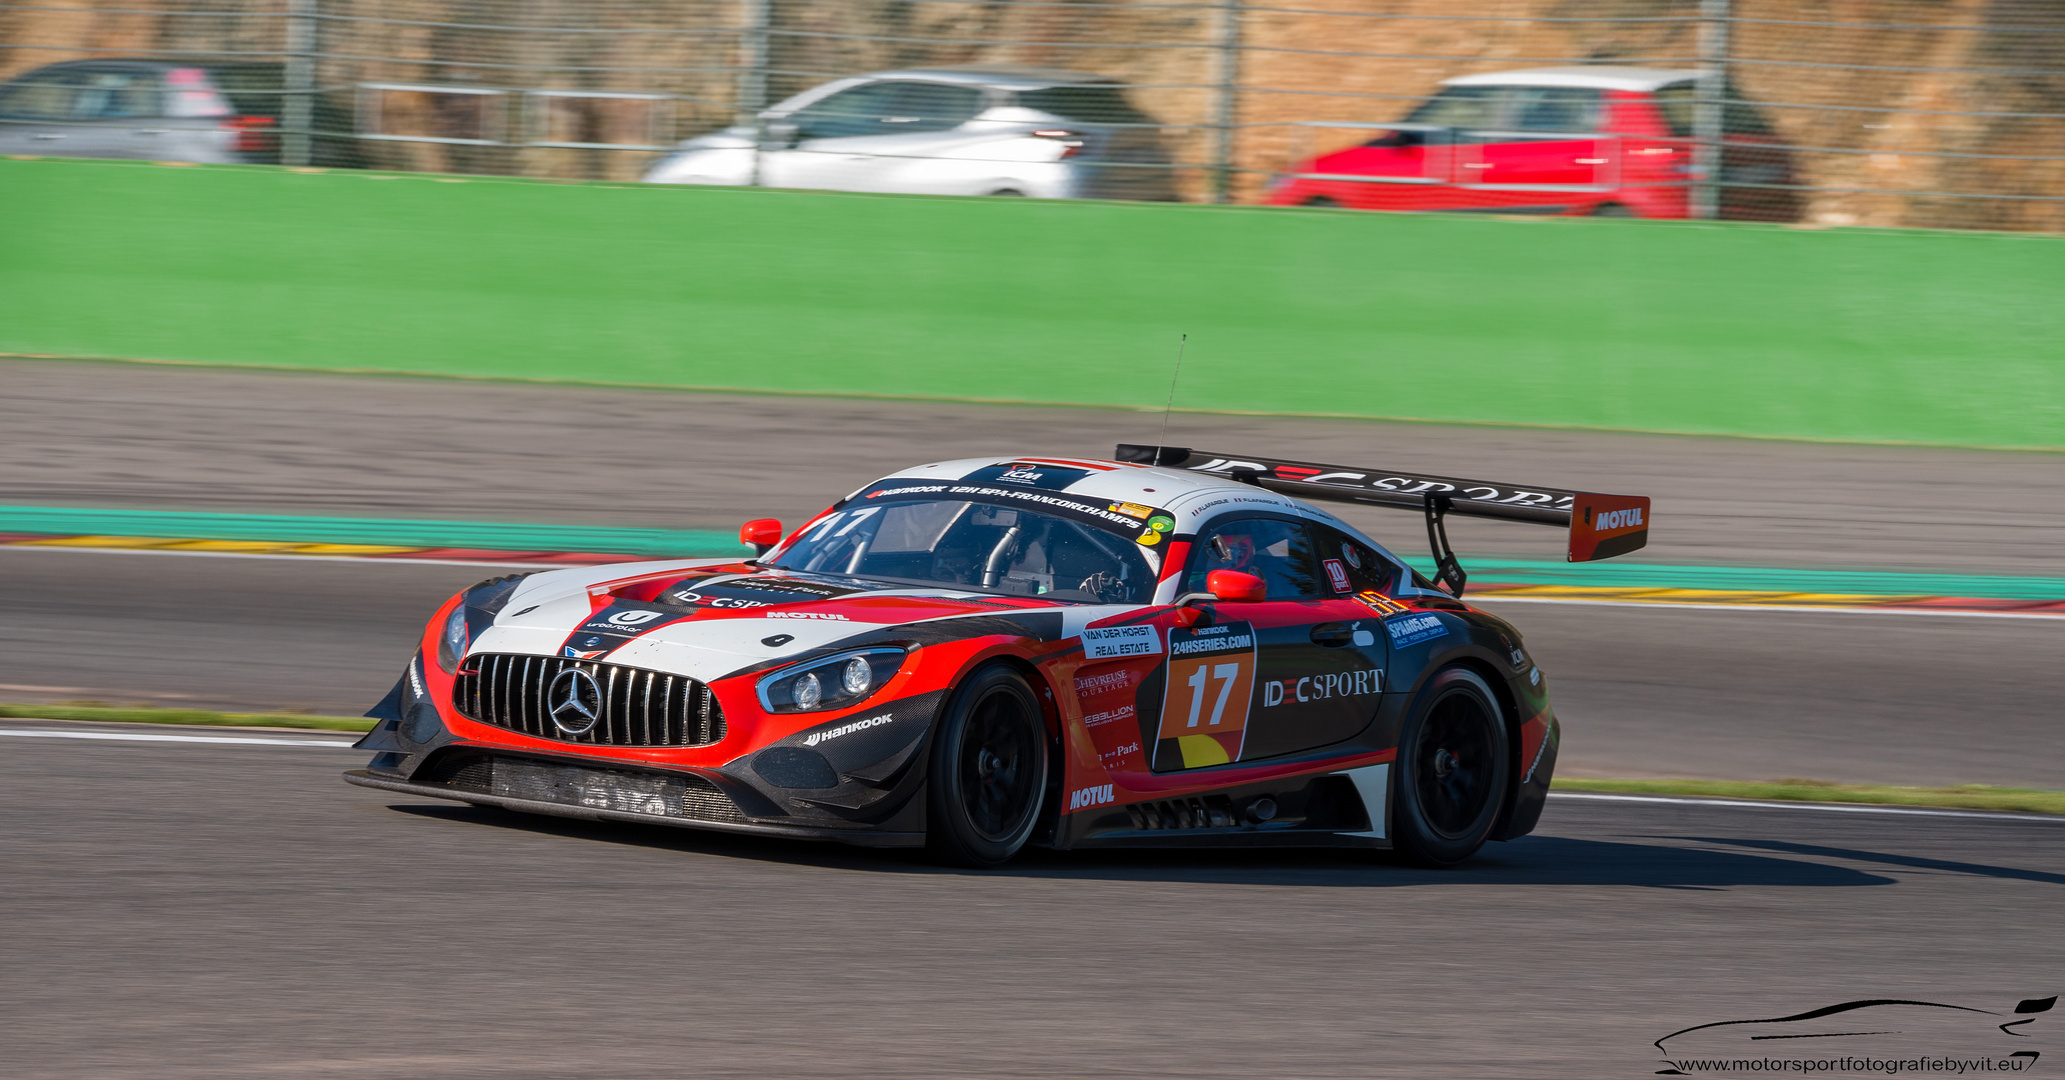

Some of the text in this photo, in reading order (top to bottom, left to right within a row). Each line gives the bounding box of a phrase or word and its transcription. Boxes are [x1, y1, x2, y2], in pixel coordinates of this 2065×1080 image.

[980, 487, 1143, 529] SPA-FRANCORCHAMPS
[809, 506, 882, 543] 17
[1594, 507, 1644, 531] MOTUL
[1327, 562, 1346, 582] 10
[673, 590, 733, 608] IDEC
[791, 586, 834, 596] Park
[766, 611, 850, 621] MOTUL
[1083, 626, 1150, 640] VAN DER HORST
[1095, 642, 1150, 657] REAL ESTATE
[1172, 634, 1252, 656] 24HSERIES.COM
[1186, 662, 1239, 729] 17
[1264, 668, 1385, 708] IDEC SPORT
[1117, 741, 1139, 757] Park
[1069, 784, 1115, 811] MOTUL
